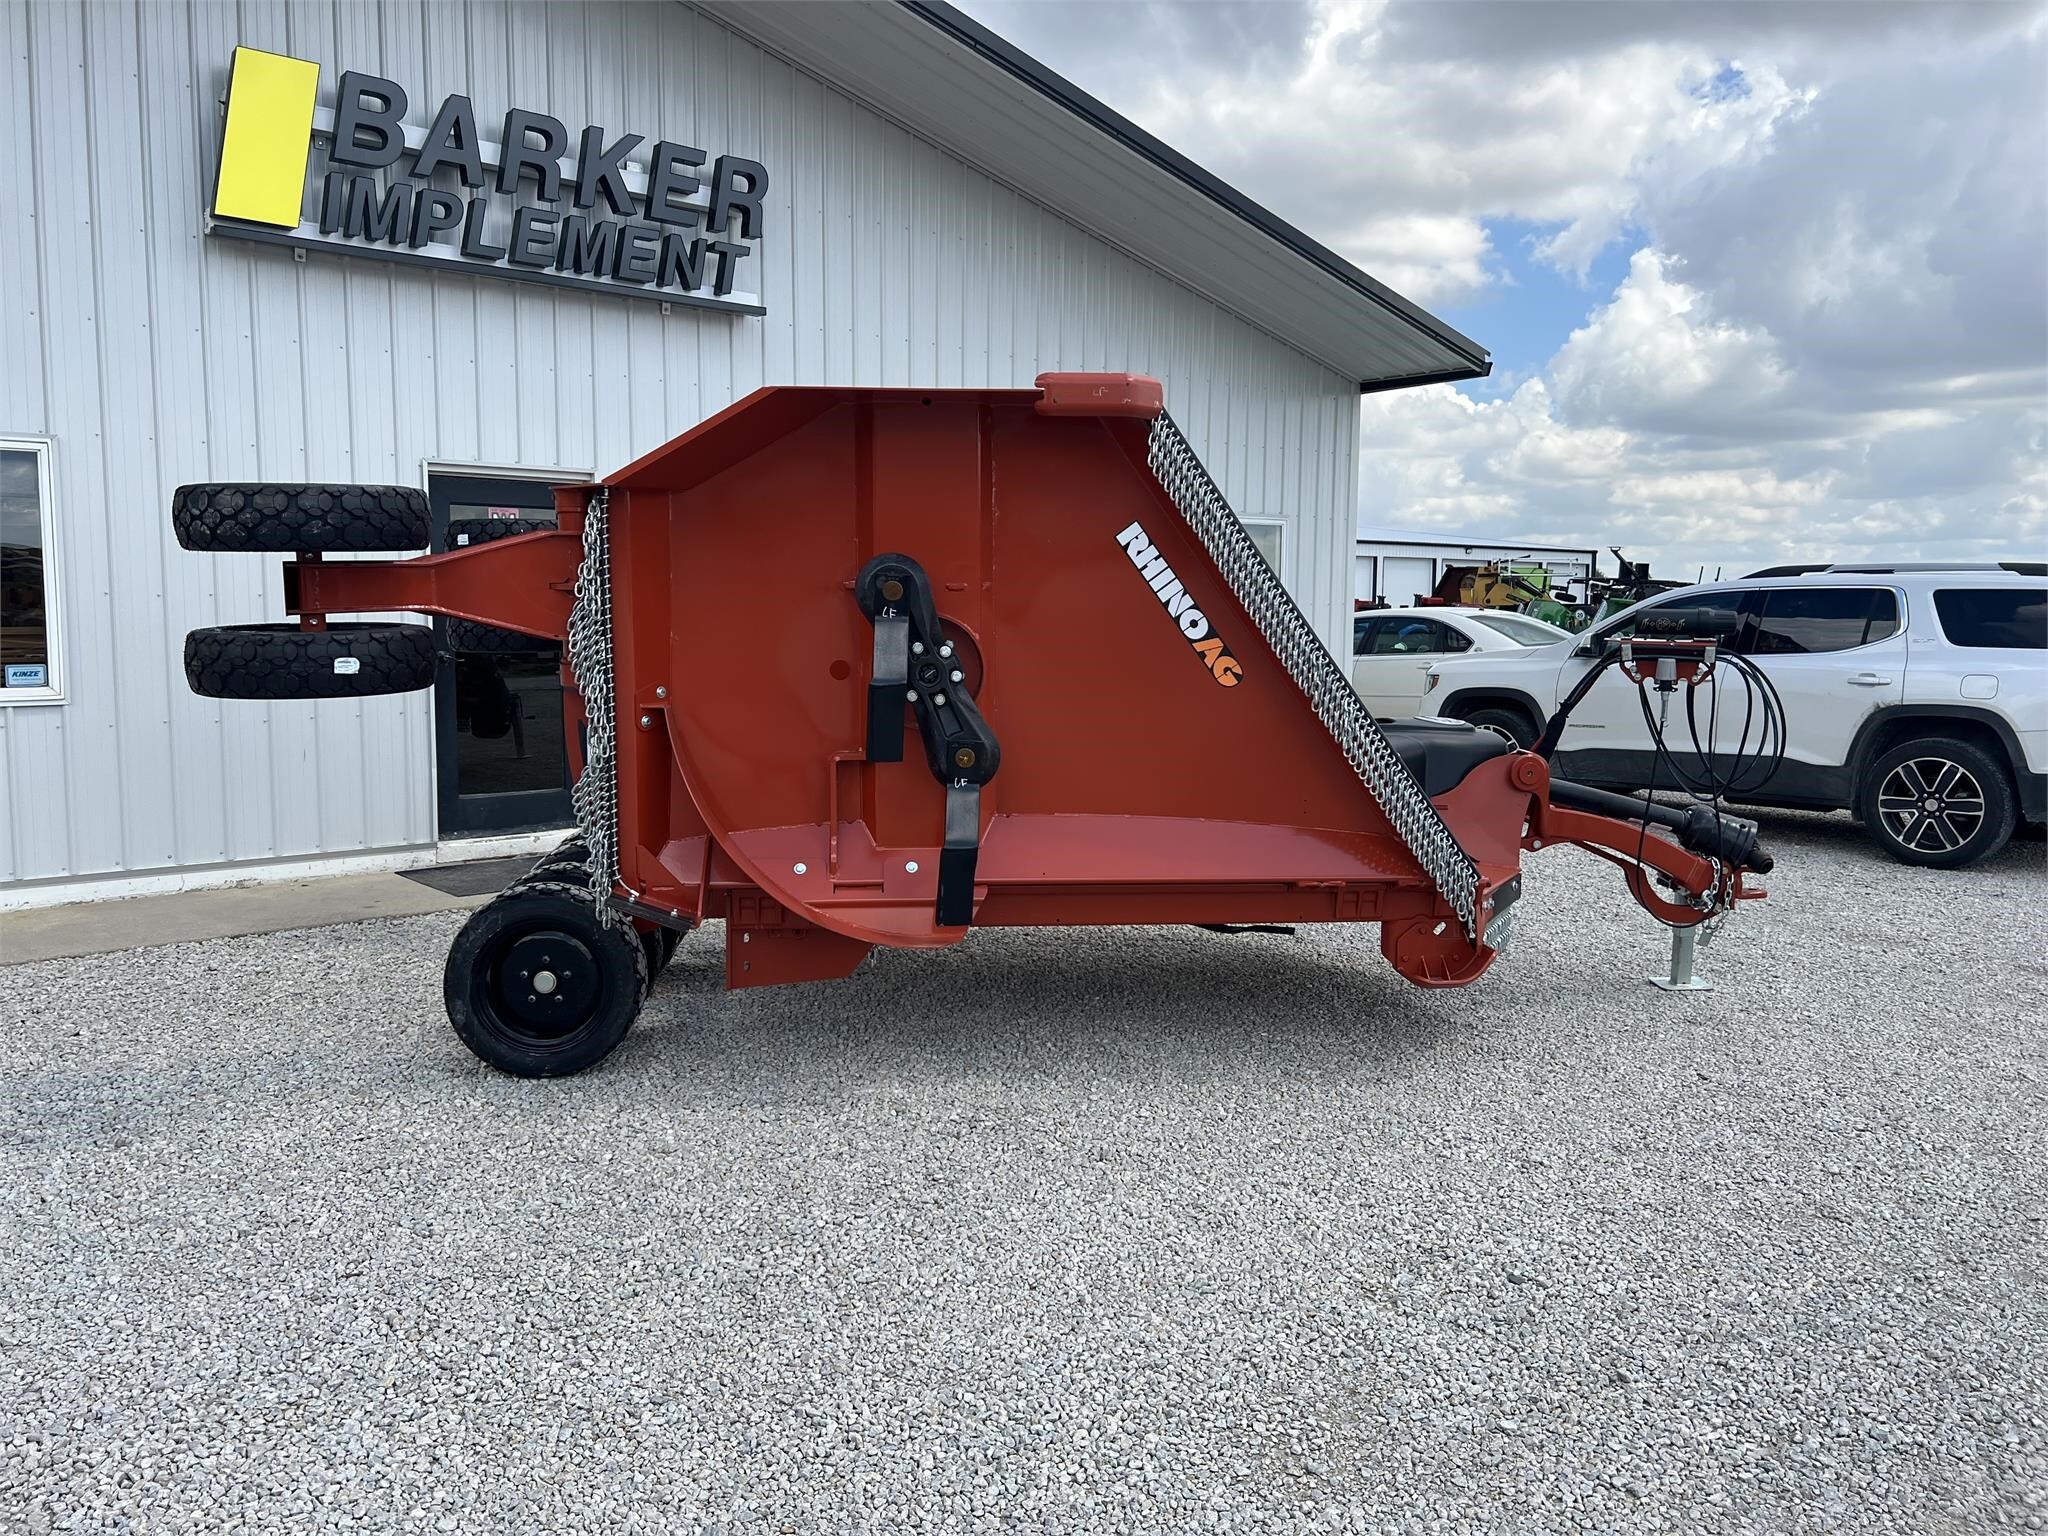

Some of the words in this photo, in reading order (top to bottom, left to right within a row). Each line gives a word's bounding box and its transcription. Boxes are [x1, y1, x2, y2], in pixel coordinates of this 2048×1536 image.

[329, 70, 769, 240] BARKER
[319, 171, 750, 296] IMPLEMENT
[882, 606, 897, 619] LF
[12, 670, 41, 678] KINZE
[954, 777, 969, 789] LF
